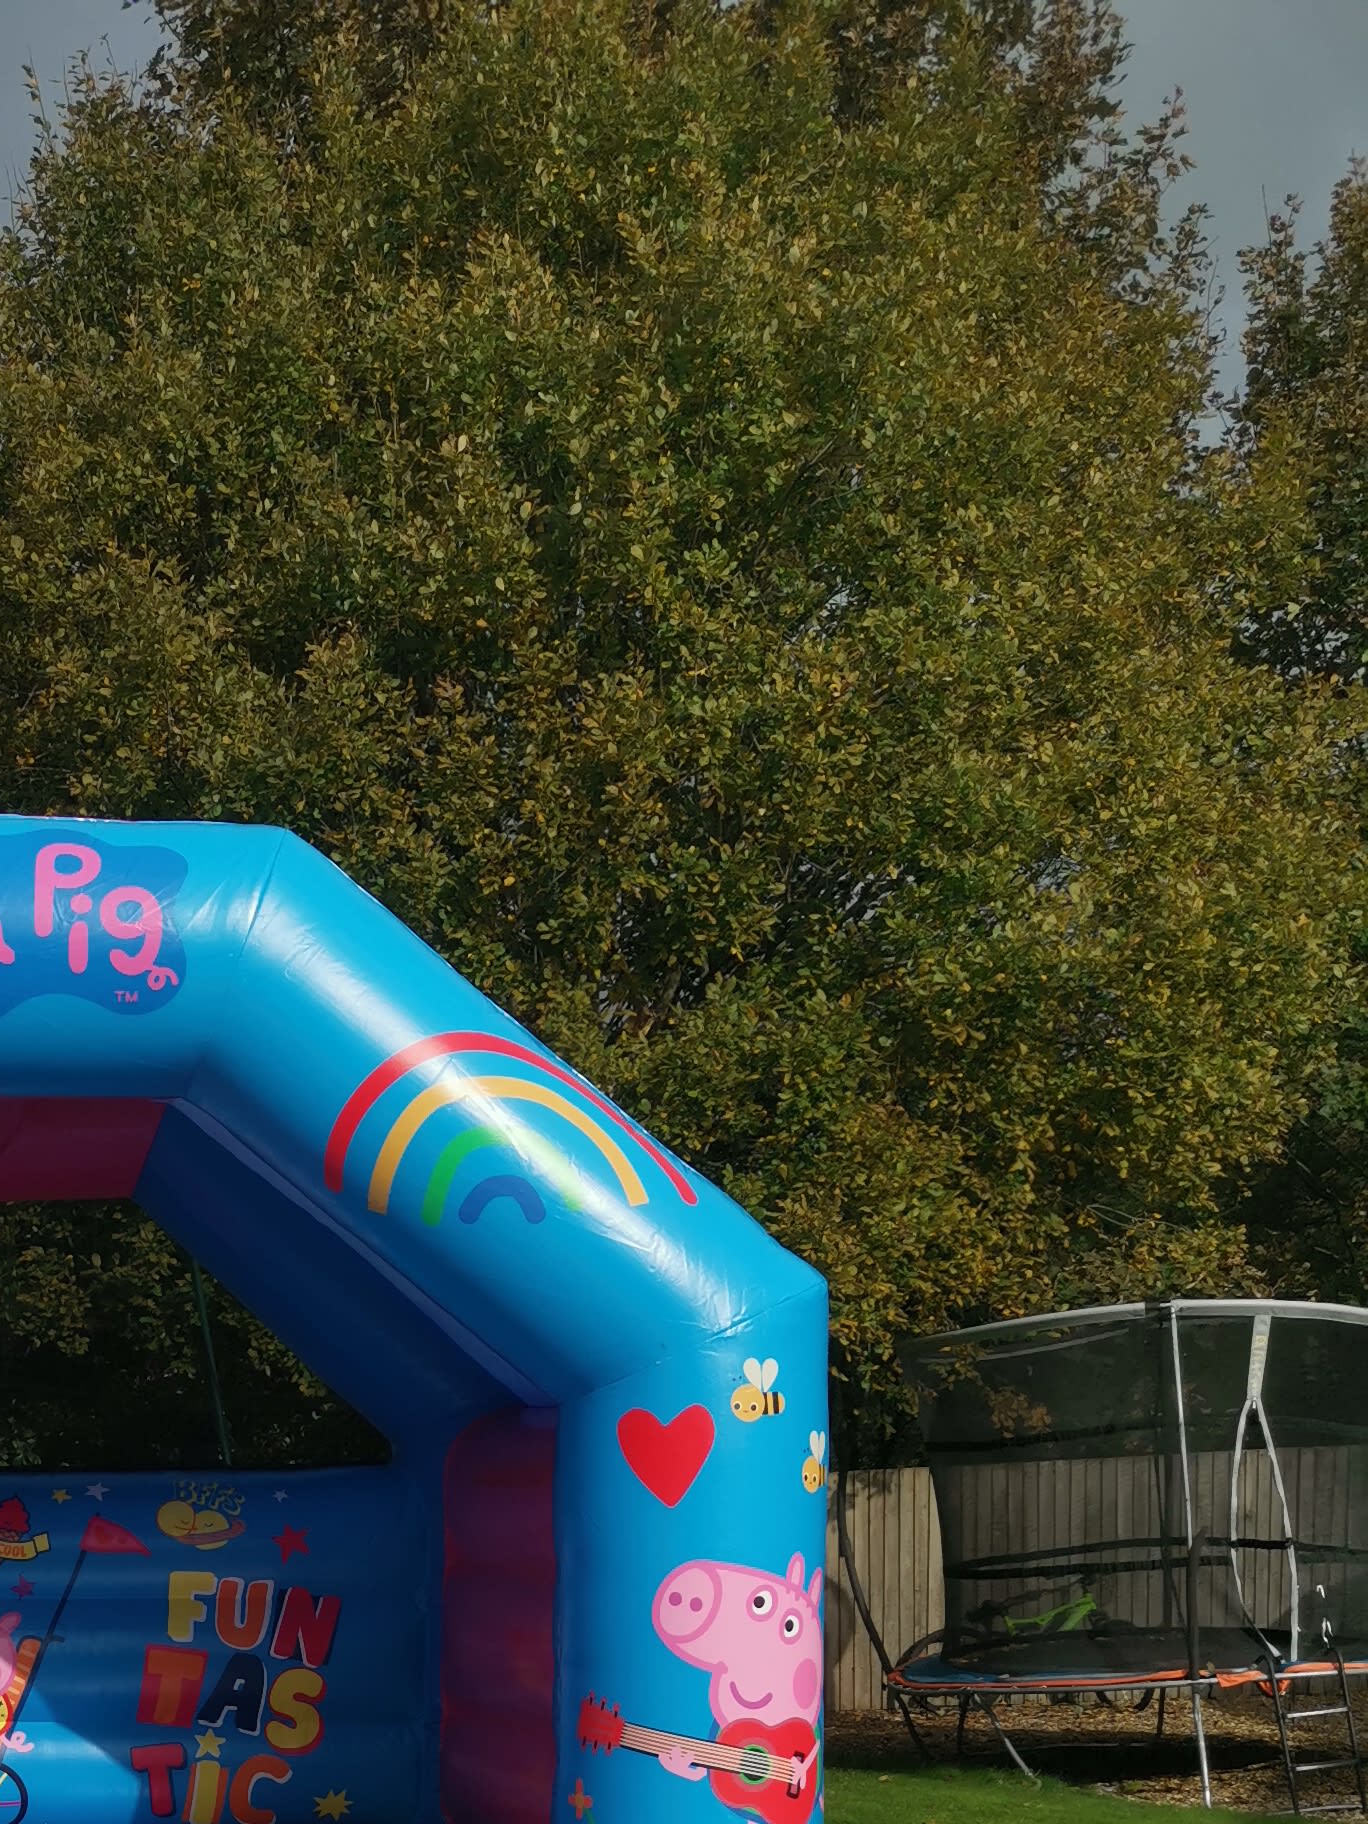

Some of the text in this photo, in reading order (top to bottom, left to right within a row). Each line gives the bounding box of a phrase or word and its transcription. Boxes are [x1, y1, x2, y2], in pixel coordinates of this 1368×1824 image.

[34, 843, 179, 990] Pig
[114, 990, 138, 1004] TM
[167, 1570, 342, 1669] FUN
[137, 1644, 328, 1756] TAS
